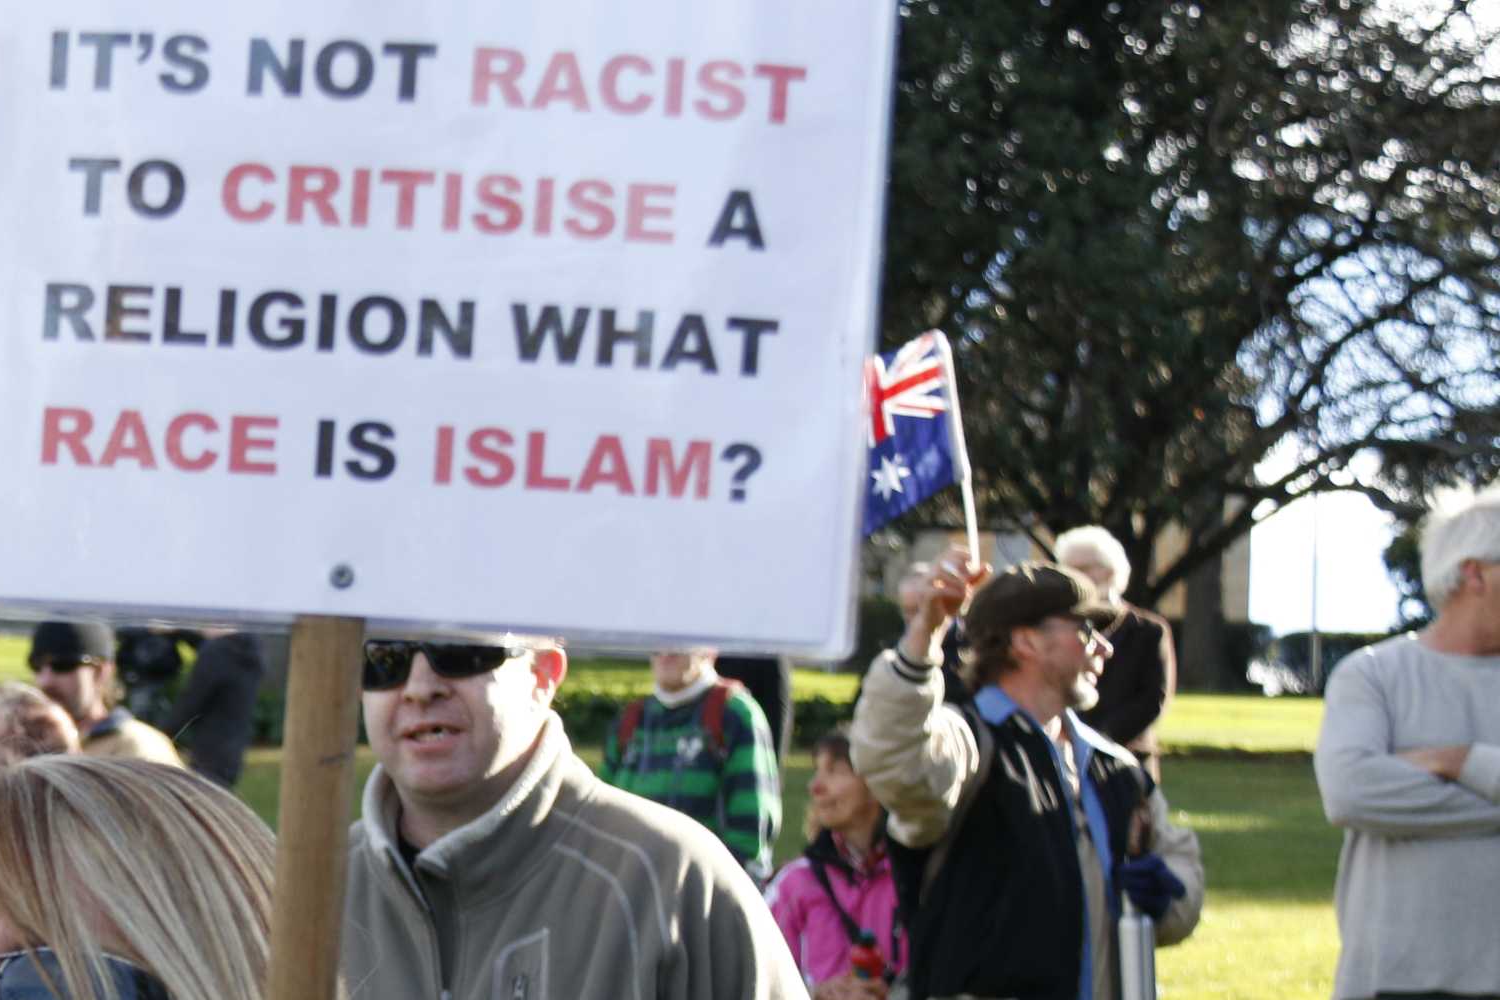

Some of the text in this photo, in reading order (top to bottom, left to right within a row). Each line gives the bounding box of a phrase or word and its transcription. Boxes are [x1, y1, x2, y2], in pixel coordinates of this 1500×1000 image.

[48, 30, 808, 126] IT'S NOT RACIST
[68, 157, 767, 252] TO CRITISISE A
[42, 283, 781, 379] RELIGION WHAT
[40, 407, 764, 504] RACE IS ISLAM?
